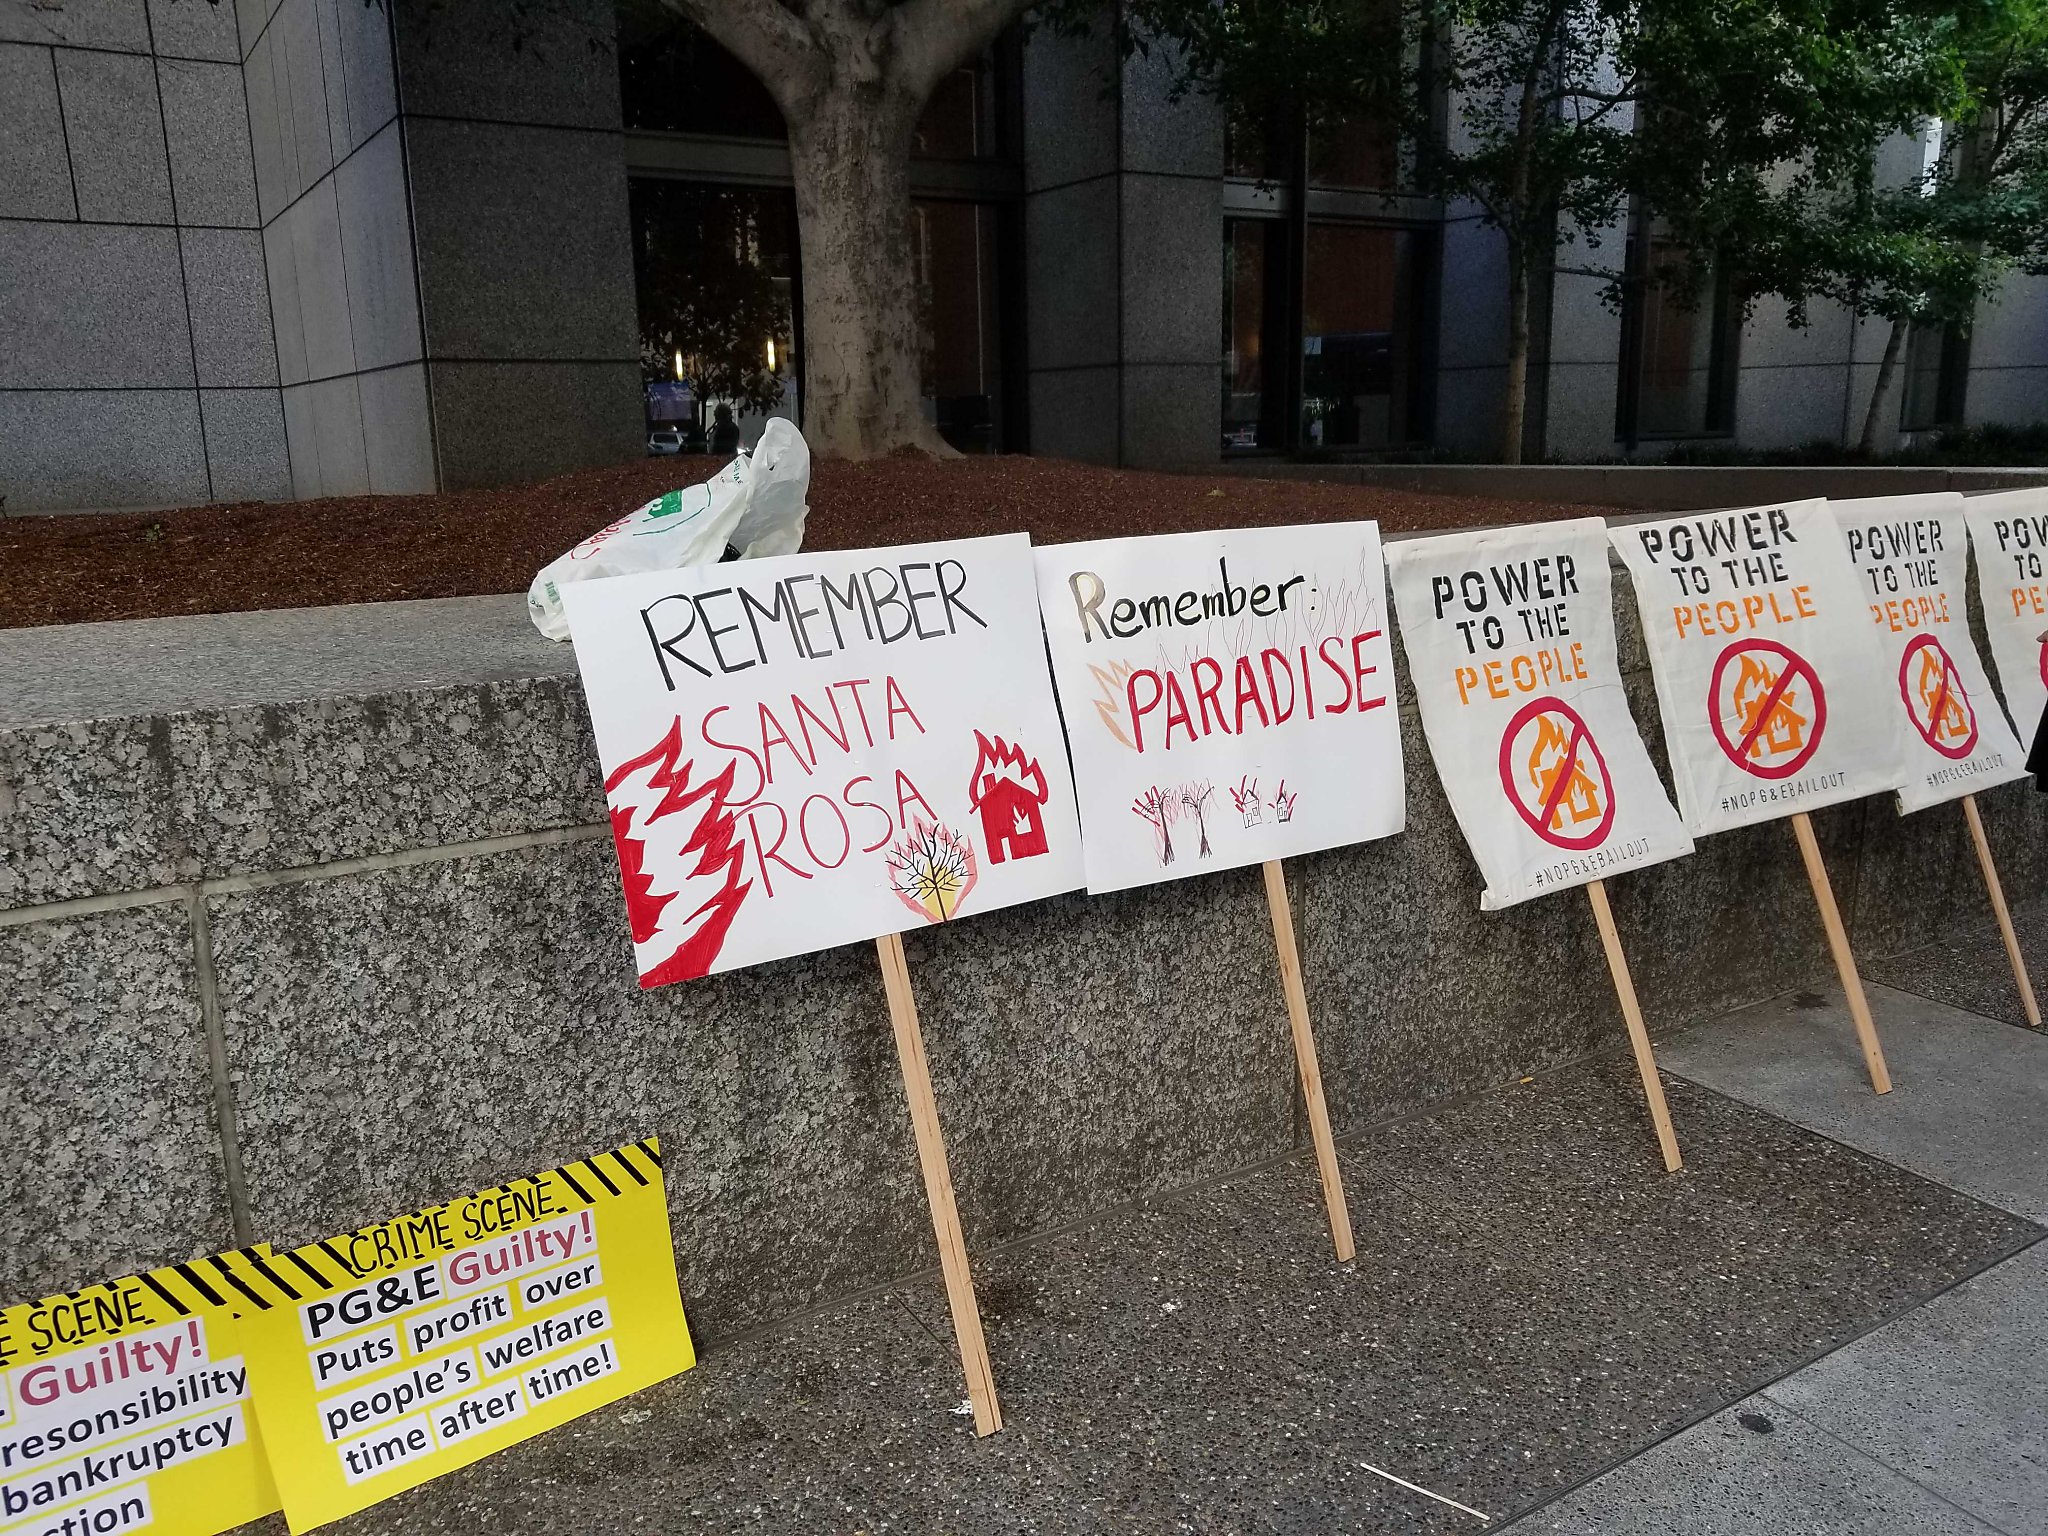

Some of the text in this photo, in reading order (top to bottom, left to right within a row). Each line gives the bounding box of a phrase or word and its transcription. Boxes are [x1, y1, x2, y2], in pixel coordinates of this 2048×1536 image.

[1638, 508, 1798, 564] POWER
[1848, 520, 1944, 564] POWER
[2014, 553, 2042, 580] TO
[1068, 557, 1317, 643] Remember:
[1431, 554, 1580, 620] POWER
[1670, 552, 1790, 596] TO THE
[1867, 559, 1938, 595] TO THE
[2011, 585, 2048, 617] PE
[640, 558, 988, 691] REMEMBER
[1456, 603, 1570, 654] TO THE
[1673, 585, 1818, 640] PEOPLE
[1869, 593, 1950, 632] PEOPLE
[1127, 629, 1387, 754] PARADISE
[1454, 642, 1589, 705] PEOPLE
[701, 676, 925, 807] SANTA
[1721, 772, 1845, 813] #NOPG&EBAILOUT
[731, 768, 938, 898] ROSA
[1535, 838, 1650, 888] #NOPG&EBAILOUT
[349, 1180, 554, 1273] CRIME SCENE
[307, 1211, 592, 1338] PG&E Guilty!
[28, 1287, 146, 1351] SCENE
[316, 1263, 595, 1381] Puts profit over
[19, 1320, 202, 1405] Guilty!
[326, 1307, 604, 1440] people's welfare
[1, 1366, 246, 1467] resonsibility
[346, 1343, 613, 1475] time after time!
[1, 1416, 233, 1517] bankruptcy
